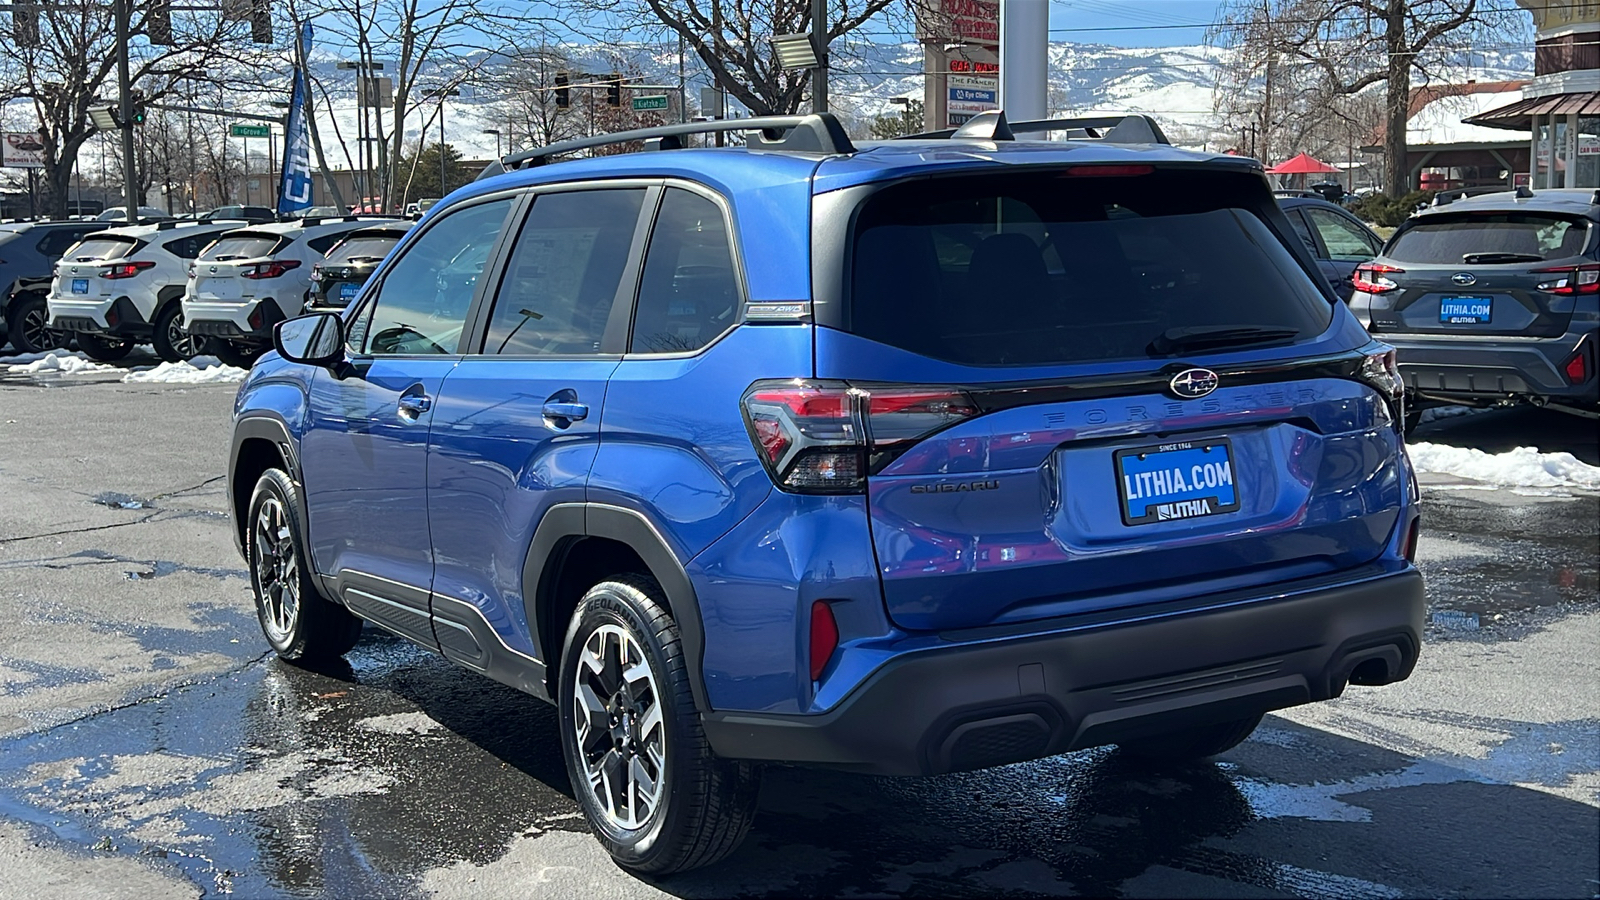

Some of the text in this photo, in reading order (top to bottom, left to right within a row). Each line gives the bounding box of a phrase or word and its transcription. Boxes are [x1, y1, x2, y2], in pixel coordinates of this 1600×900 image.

[965, 91, 974, 100] Eye
[1441, 304, 1490, 315] LITHIA.COM
[1043, 388, 1315, 428] FORESTER
[1159, 444, 1178, 452] SINCE
[910, 480, 1000, 494] SUBARU
[1124, 461, 1232, 500] LITHIA.COM
[1169, 499, 1212, 518] LITHIA
